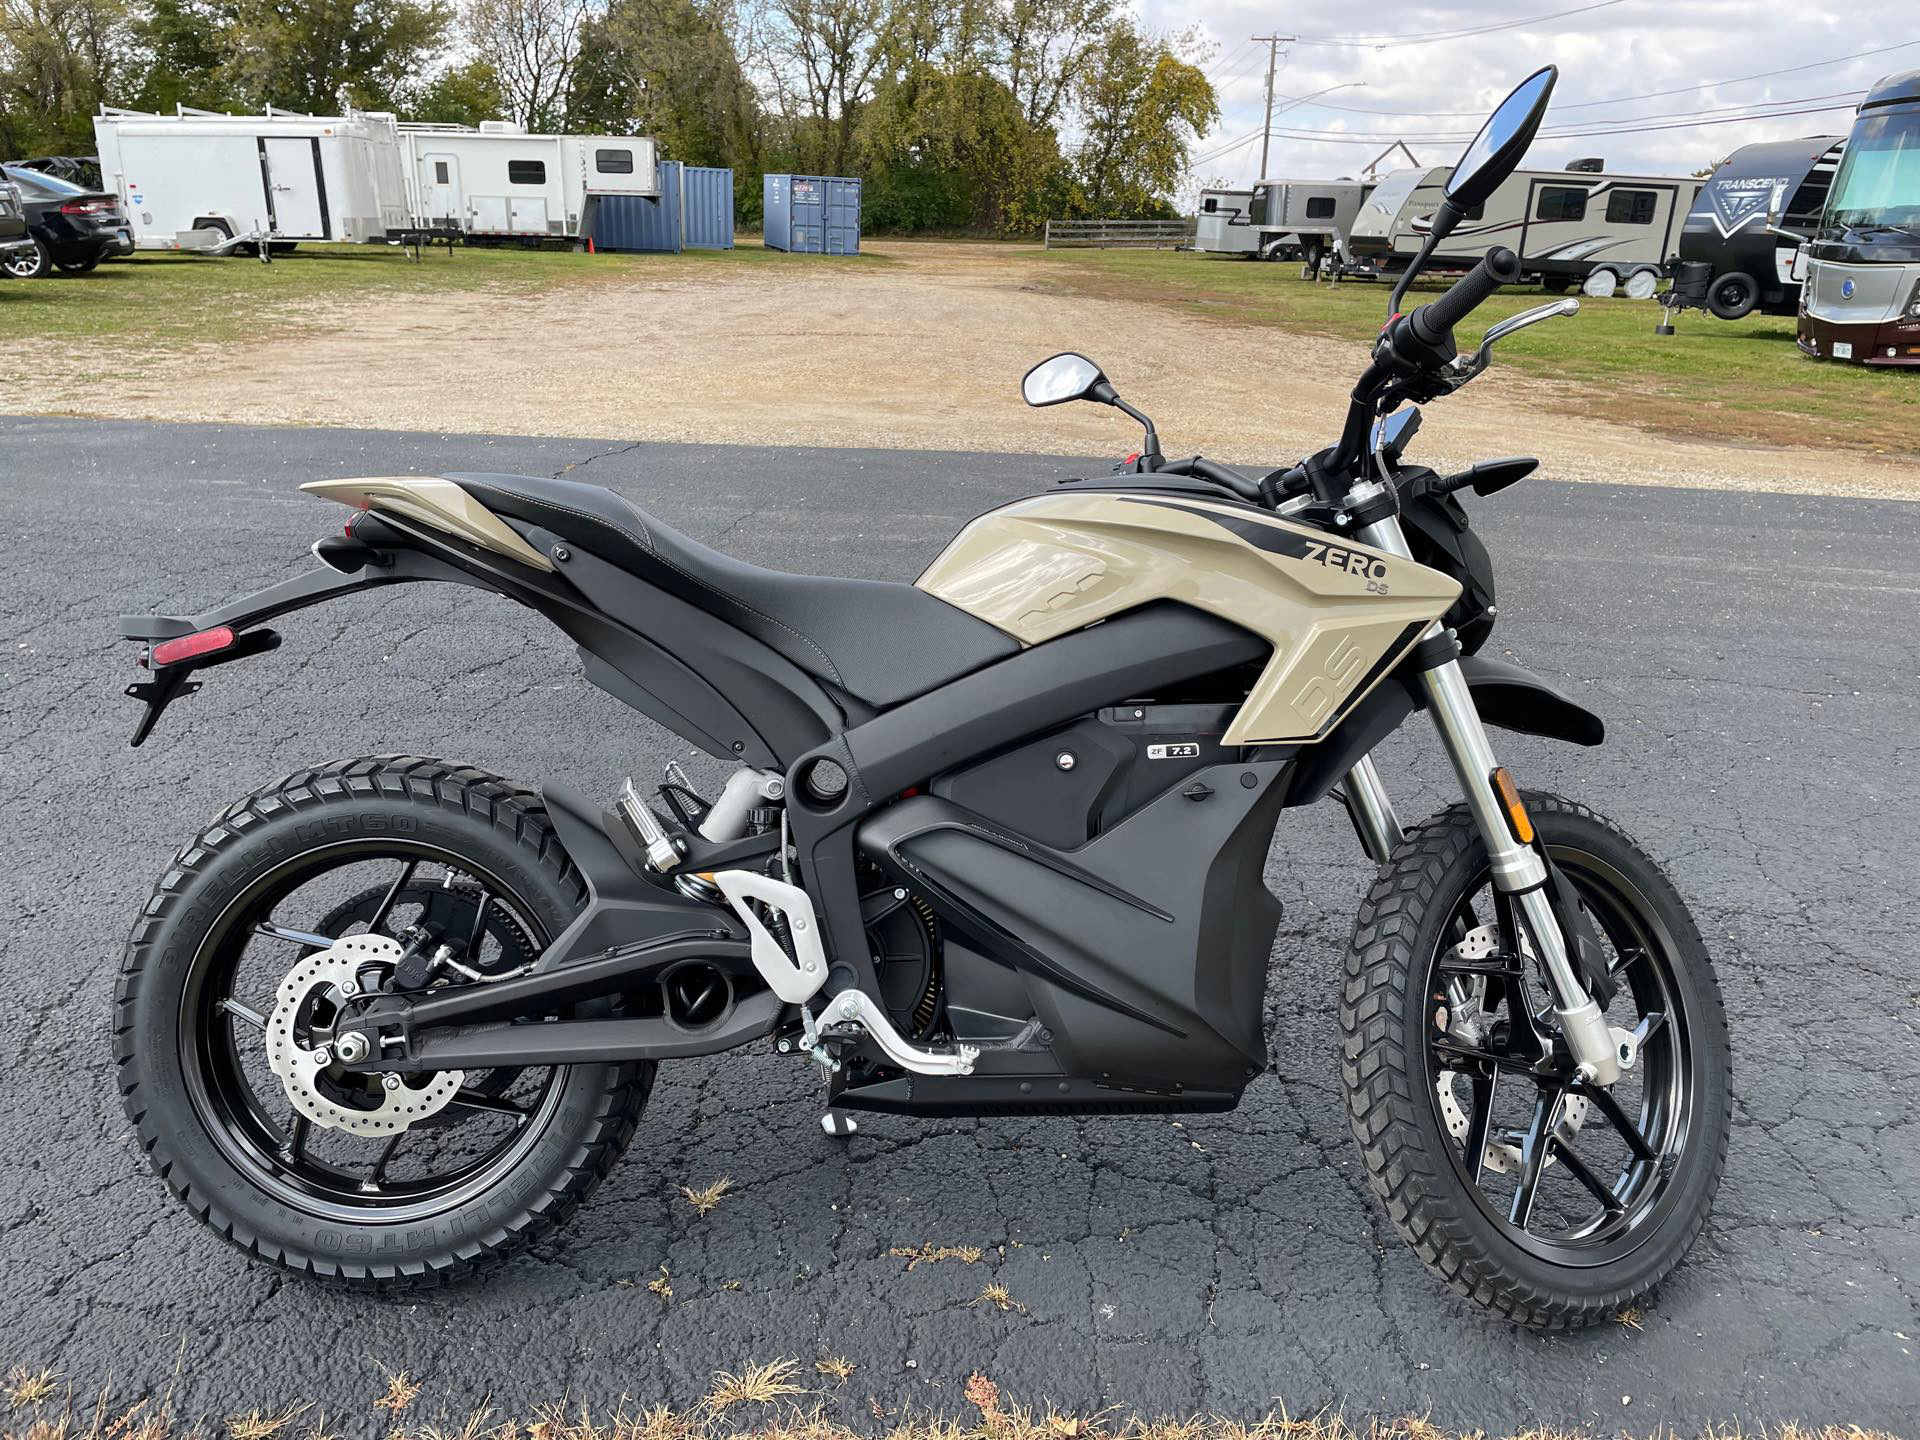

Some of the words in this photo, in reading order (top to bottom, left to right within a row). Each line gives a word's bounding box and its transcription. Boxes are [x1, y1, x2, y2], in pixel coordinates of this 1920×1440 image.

[1716, 177, 1790, 190] TRANSCEND
[1302, 541, 1388, 579] ZERO
[1366, 580, 1389, 595] DS
[1290, 632, 1368, 730] DS
[1171, 746, 1192, 755] 7.2
[295, 812, 418, 842] MT60
[313, 1225, 437, 1254] MT60
